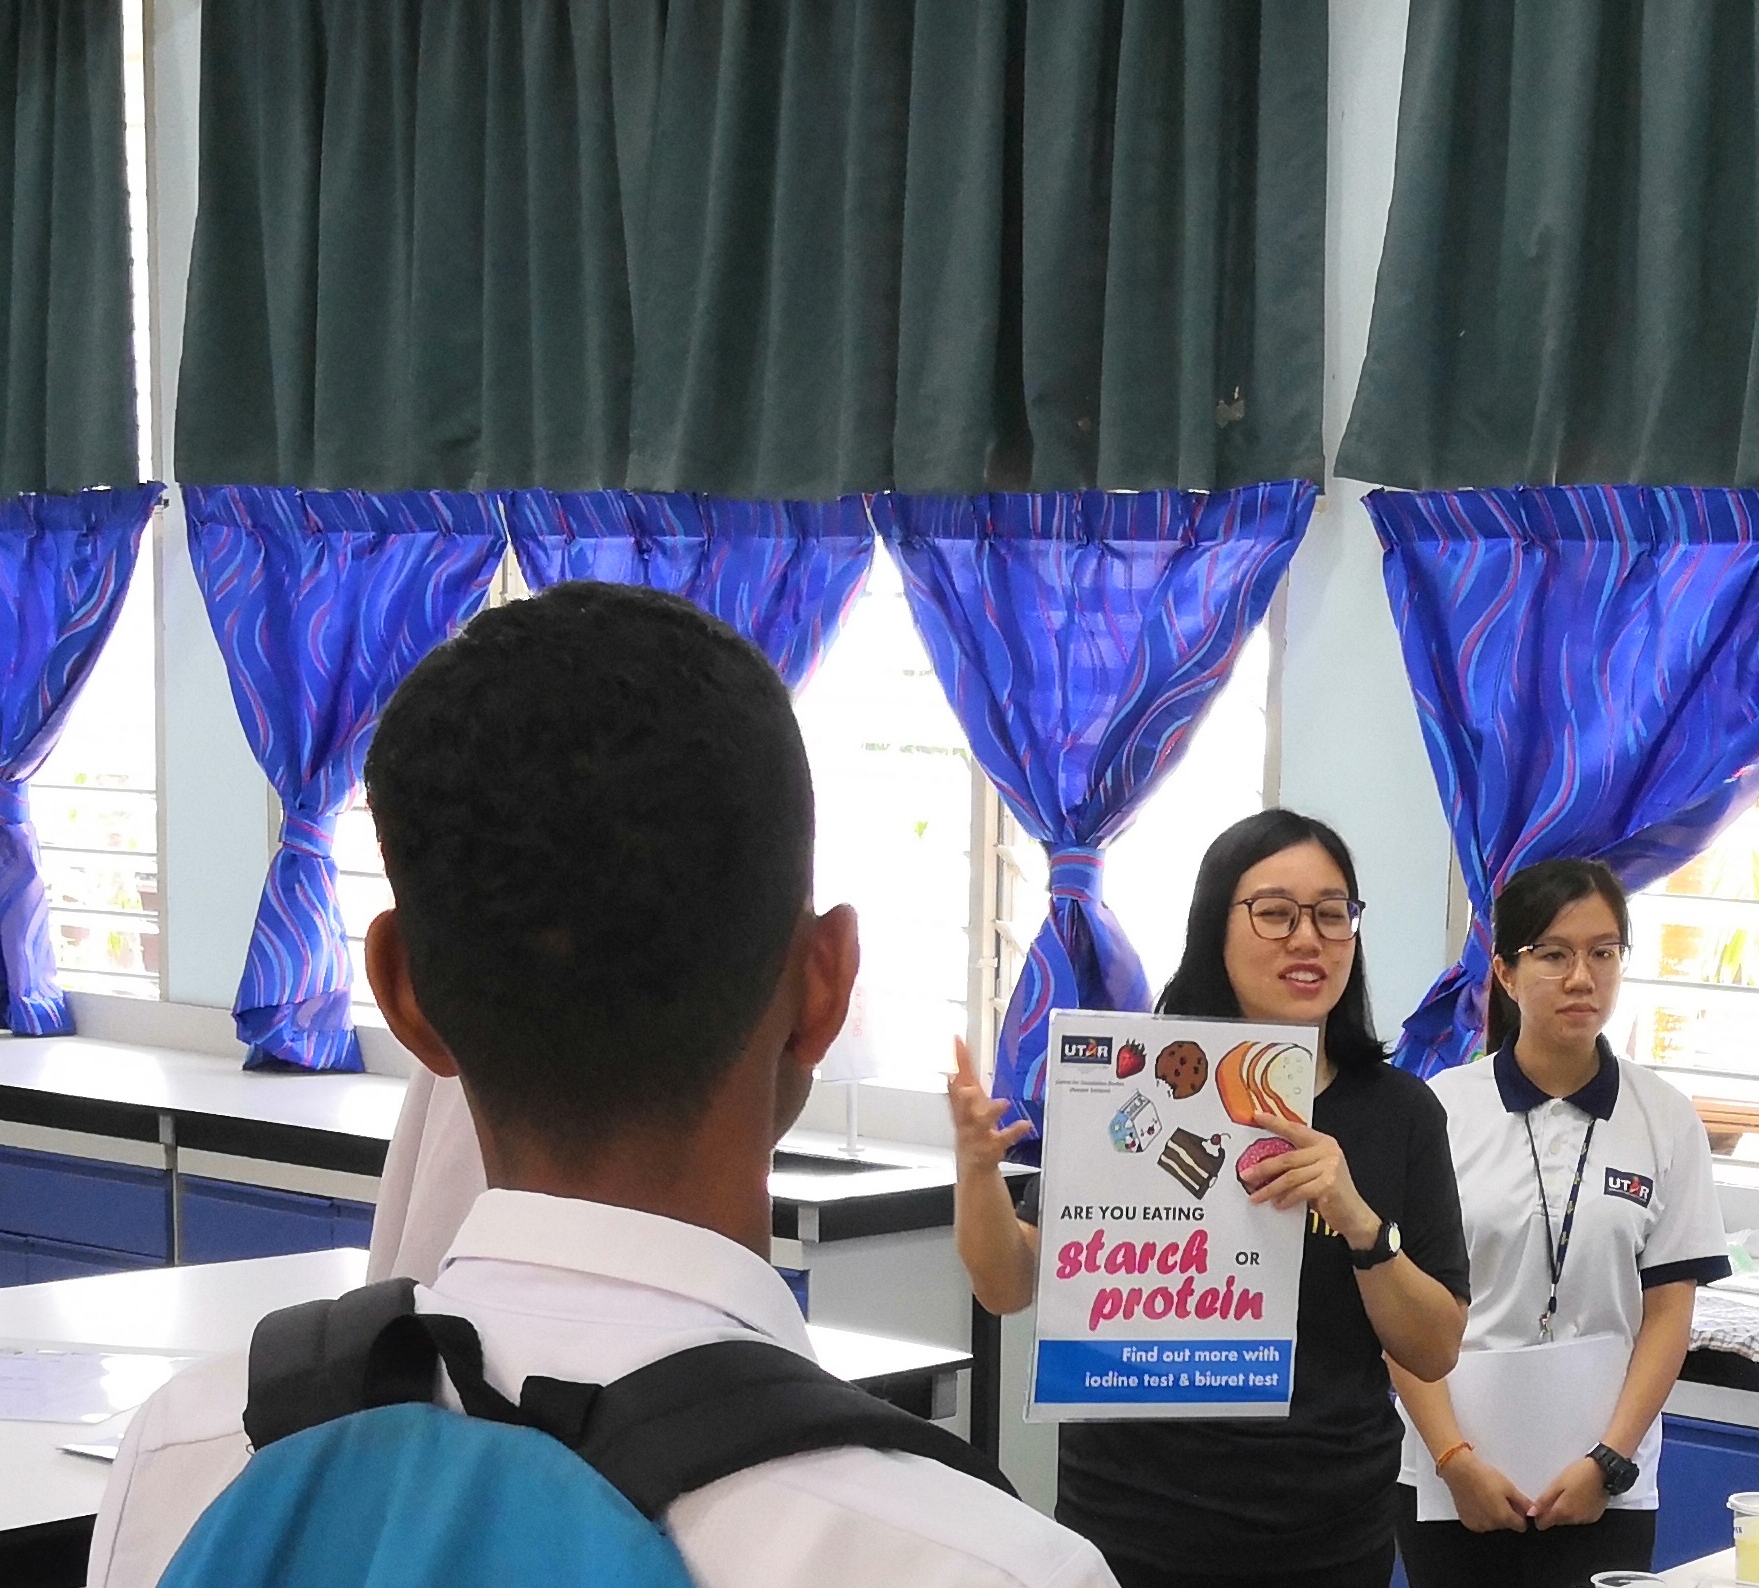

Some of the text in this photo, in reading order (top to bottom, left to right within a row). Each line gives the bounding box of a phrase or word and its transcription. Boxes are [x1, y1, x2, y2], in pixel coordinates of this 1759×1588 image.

[1060, 1205, 1205, 1221] ARE YOU EATING
[1056, 1229, 1260, 1279] starch OR
[1088, 1275, 1265, 1332] protein
[1122, 1345, 1280, 1362] Find out more with
[1085, 1371, 1279, 1388] iodine test & biuret test
